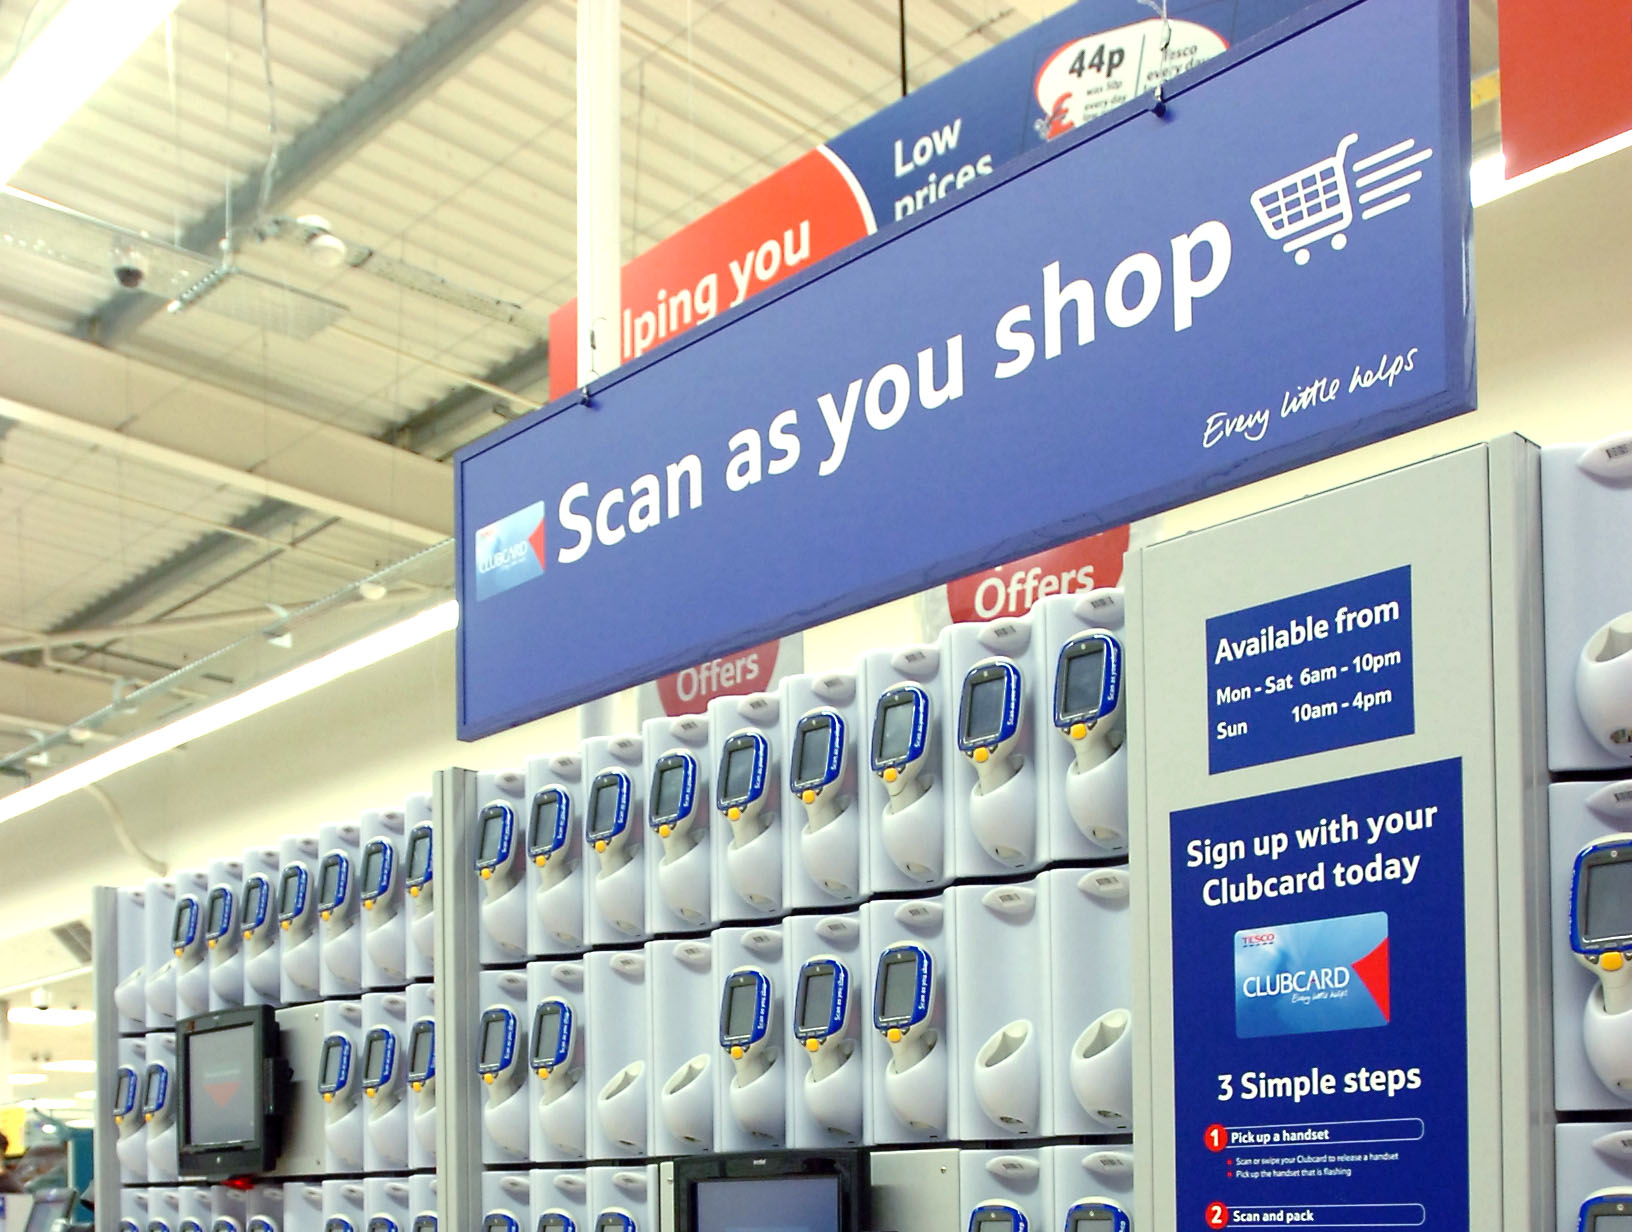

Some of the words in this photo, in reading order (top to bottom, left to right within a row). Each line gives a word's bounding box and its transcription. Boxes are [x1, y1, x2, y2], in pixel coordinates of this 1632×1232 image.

[1068, 43, 1126, 78] 44p
[893, 118, 963, 178] Low
[894, 153, 994, 222] prices
[621, 272, 718, 360] lping
[728, 218, 811, 309] you
[558, 451, 703, 564] Scan
[727, 412, 802, 492] as
[818, 333, 963, 473] you
[996, 217, 1232, 378] shop
[1202, 408, 1270, 448] Every
[1281, 377, 1341, 418] little
[1348, 347, 1418, 393] helps
[478, 540, 528, 575] CLUBCARD
[974, 564, 1096, 620] Offers
[1214, 614, 1329, 665] Available
[1334, 600, 1400, 634] from
[676, 649, 760, 702] Offers
[1216, 685, 1251, 706] Mon
[1264, 674, 1294, 695] Sat
[1299, 666, 1337, 686] 6am
[1352, 650, 1401, 675] 10pm
[1216, 720, 1248, 740] Sun
[1292, 702, 1338, 723] 10am
[1352, 688, 1393, 712] 4pm
[1186, 838, 1246, 869] Sign
[1253, 831, 1288, 860] up
[1295, 813, 1359, 849] with
[1366, 805, 1438, 845] your
[1202, 861, 1325, 907] Clubcard
[1332, 852, 1421, 885] today
[1242, 932, 1275, 946] TESCO
[1242, 965, 1350, 998] CLUBCARD
[1217, 1074, 1233, 1101] 3
[1240, 1067, 1336, 1103] Simple
[1343, 1066, 1422, 1097] steps
[1210, 1128, 1219, 1147] 1
[1231, 1130, 1255, 1144] Pick
[1256, 1133, 1271, 1144] up
[1273, 1133, 1280, 1142] a
[1282, 1128, 1330, 1141] handset
[1236, 1157, 1252, 1166] Scan
[1281, 1157, 1296, 1166] your
[1296, 1154, 1327, 1164] Clubcard
[1369, 1152, 1399, 1161] handset
[1211, 1205, 1222, 1224] 2
[1233, 1211, 1260, 1222] Scan
[1262, 1210, 1284, 1222] and
[1286, 1210, 1314, 1225] pack
